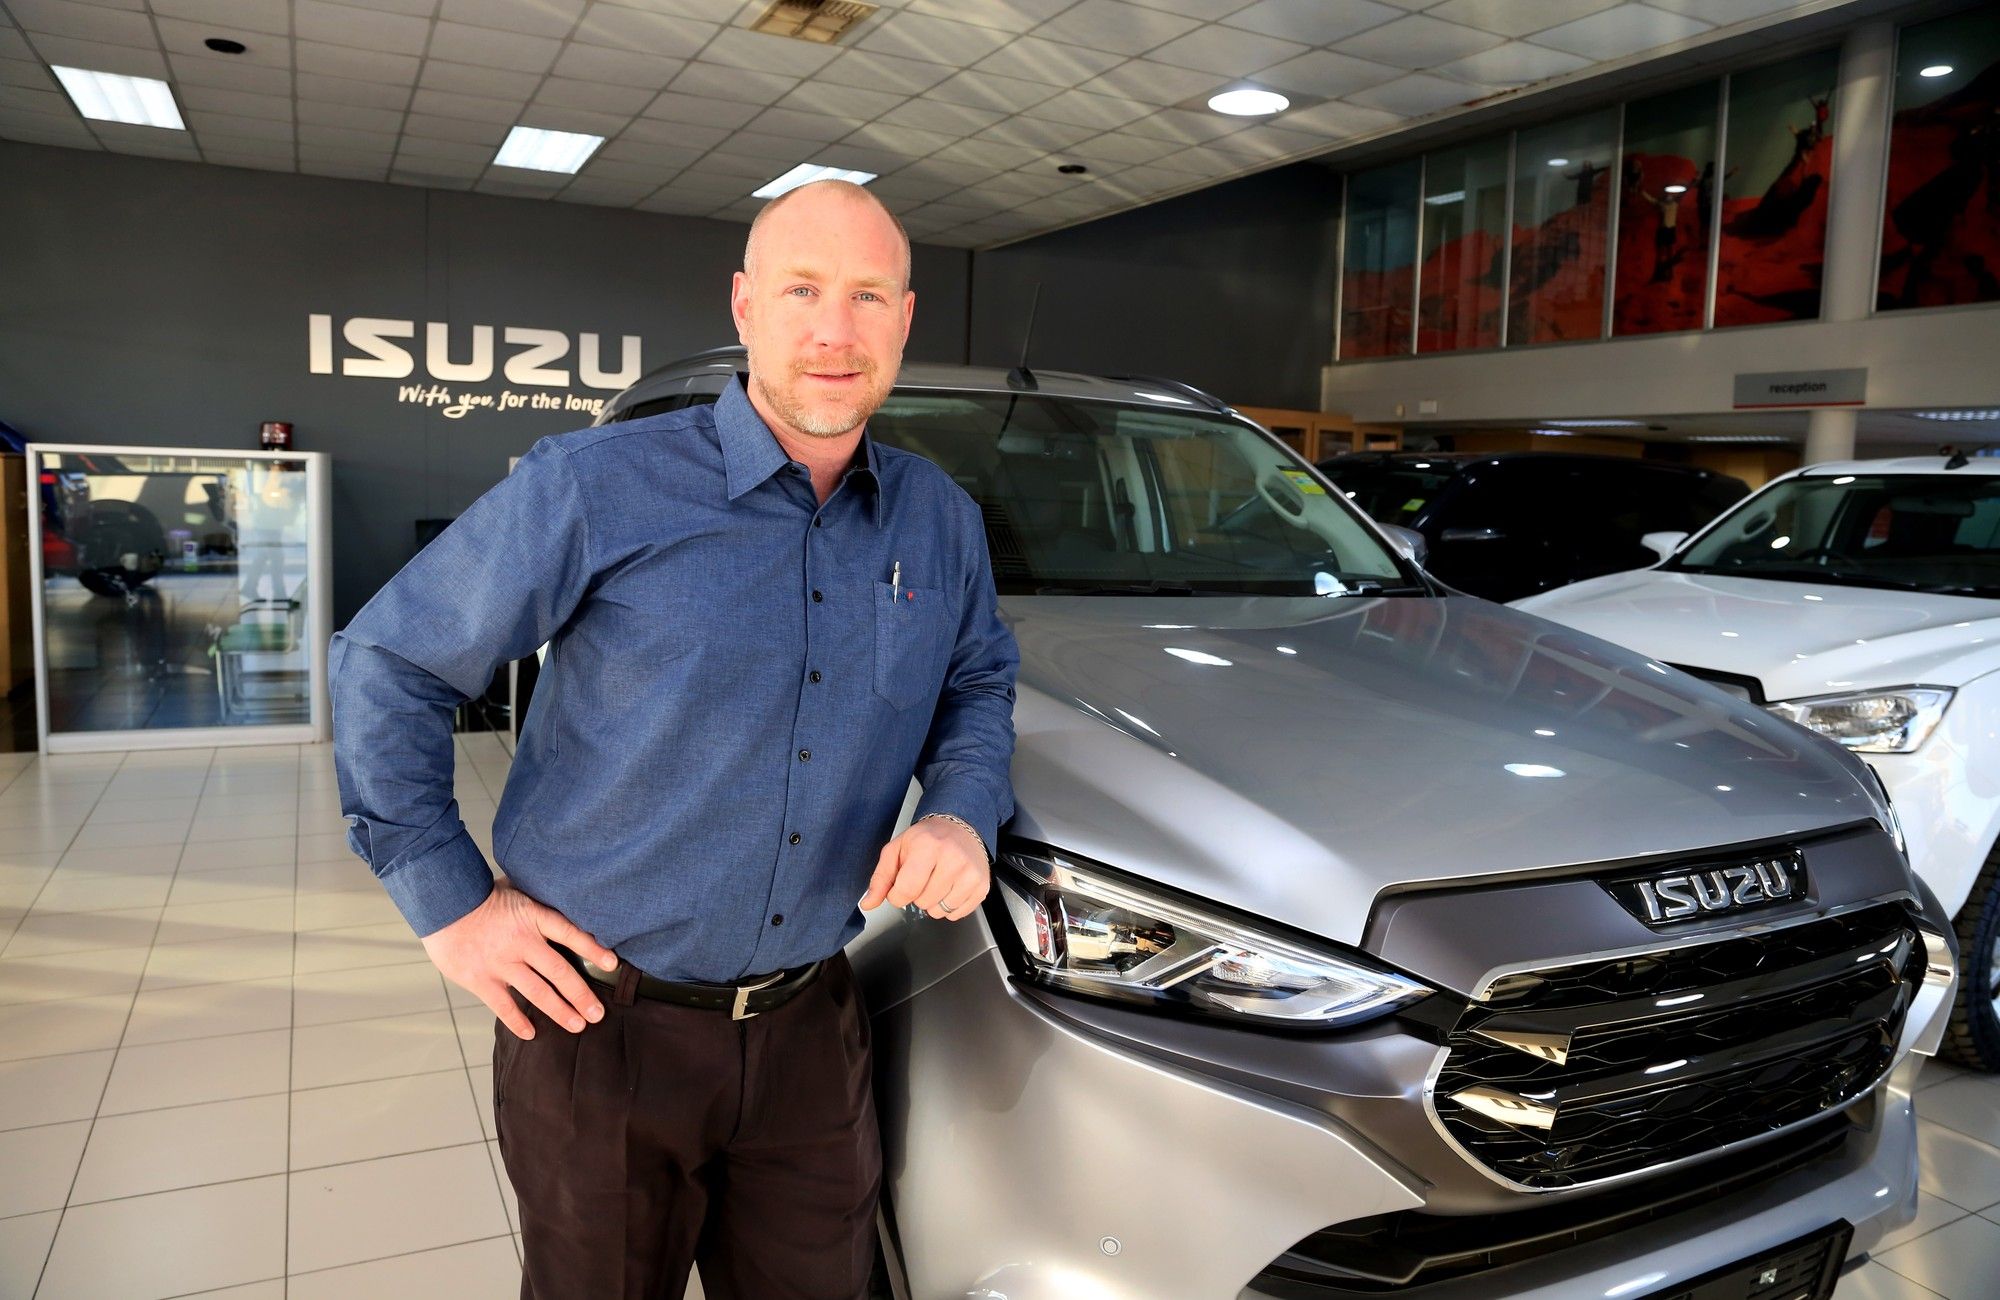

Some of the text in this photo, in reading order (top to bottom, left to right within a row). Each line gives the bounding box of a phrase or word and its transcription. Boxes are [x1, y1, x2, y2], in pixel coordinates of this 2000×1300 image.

[309, 314, 642, 389] ISUZU
[399, 384, 604, 418] With you, for the long
[1769, 382, 1827, 395] reception
[1638, 860, 1792, 920] ISUZU
